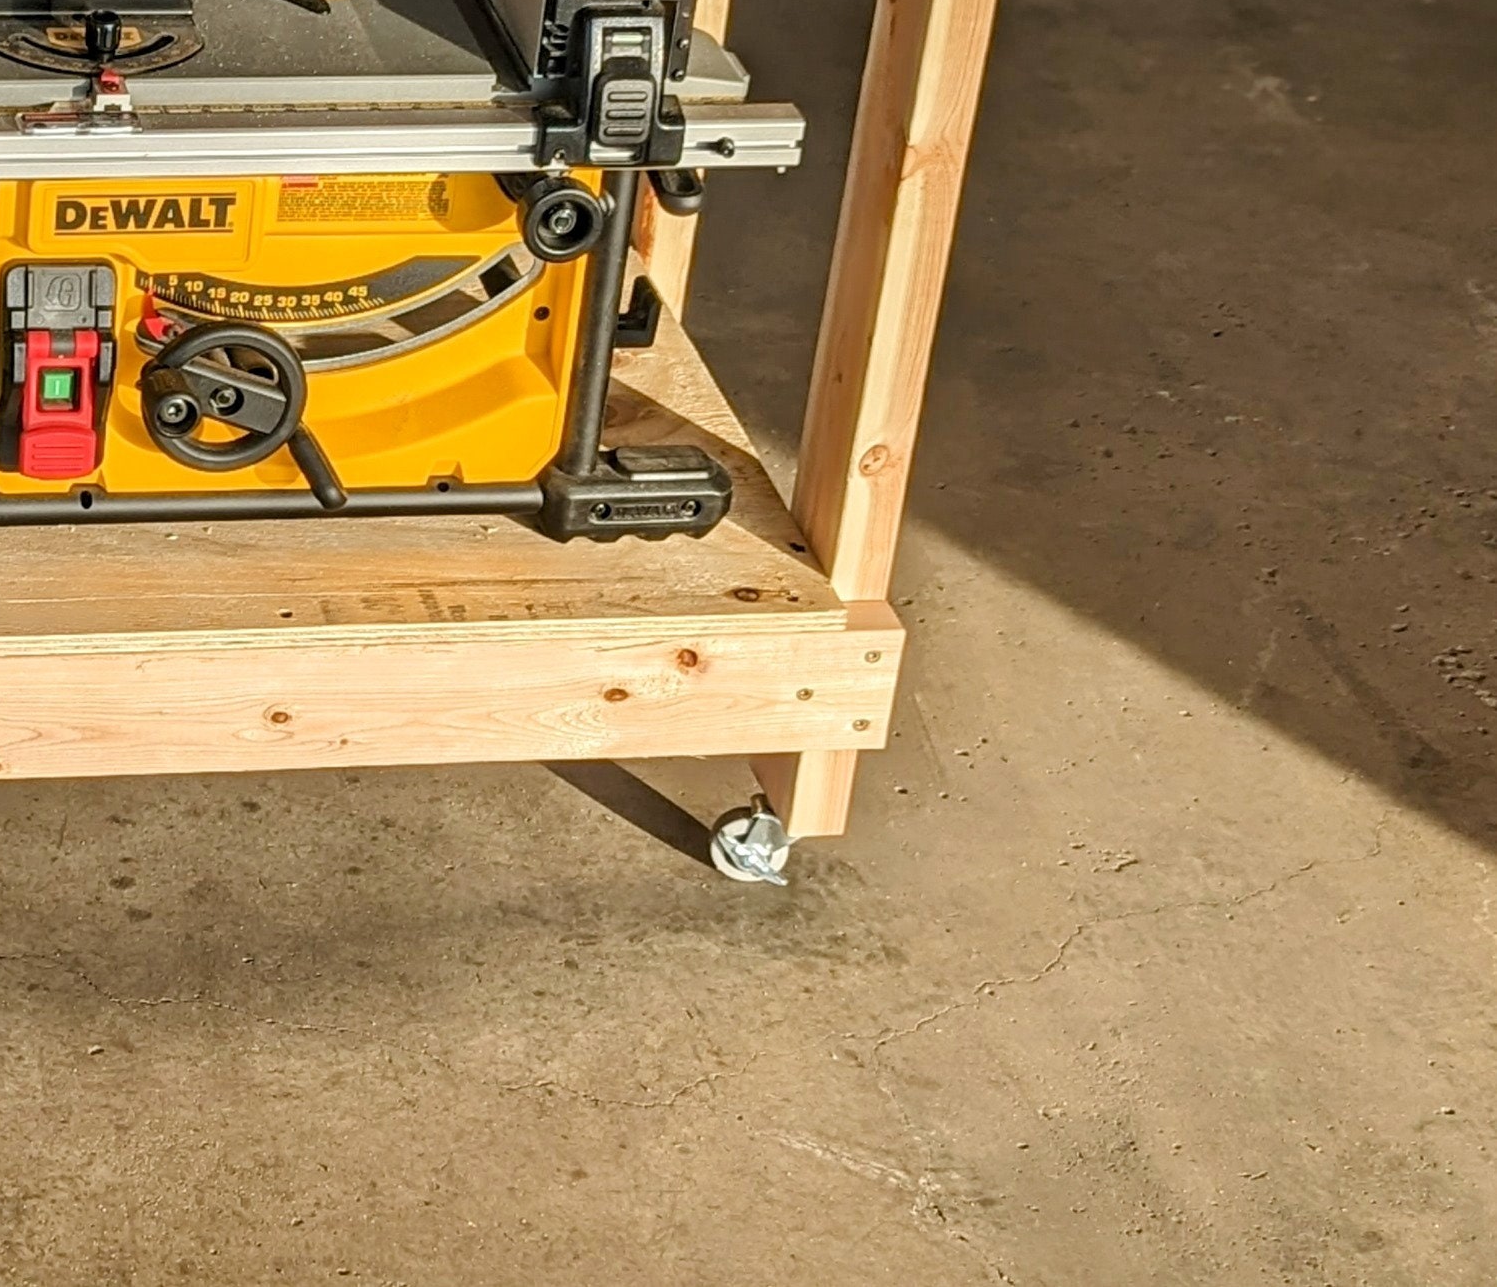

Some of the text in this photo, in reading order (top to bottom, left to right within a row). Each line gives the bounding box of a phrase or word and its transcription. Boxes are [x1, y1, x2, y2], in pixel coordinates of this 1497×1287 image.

[168, 274, 368, 308] 5 10 15 20 25 30 35 40 45
